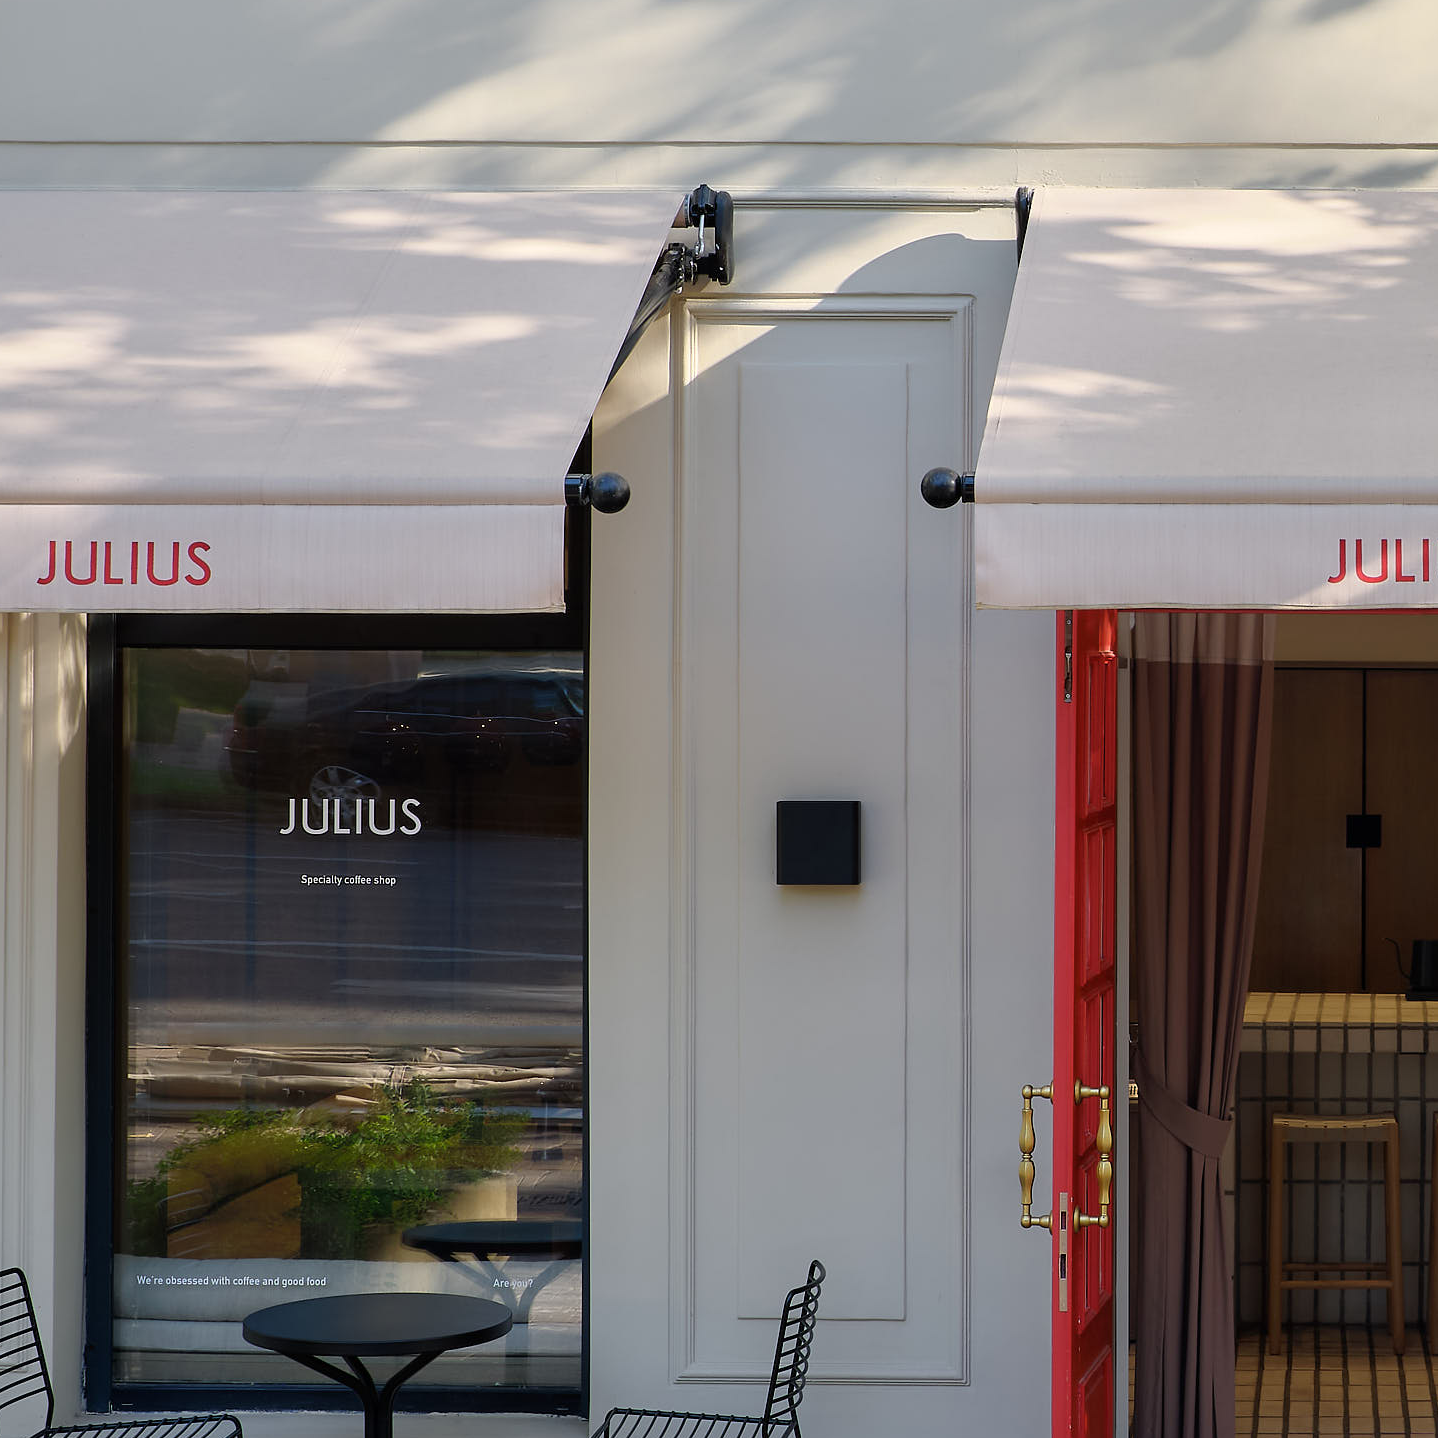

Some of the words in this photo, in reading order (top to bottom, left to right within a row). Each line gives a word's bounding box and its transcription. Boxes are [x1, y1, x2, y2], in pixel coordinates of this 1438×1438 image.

[36, 539, 212, 587] JULIUS
[279, 798, 422, 836] JULIUS
[300, 874, 343, 887] Specialty
[344, 874, 372, 885] coffee
[373, 874, 397, 887] shop
[136, 1275, 163, 1285] We're
[165, 1275, 209, 1285] obsessed
[210, 1275, 231, 1286] with
[232, 1276, 260, 1286] coffee
[262, 1276, 280, 1286] and
[281, 1276, 305, 1288] good
[306, 1276, 327, 1287] food
[493, 1278, 510, 1288] Are
[511, 1278, 534, 1290] you?
